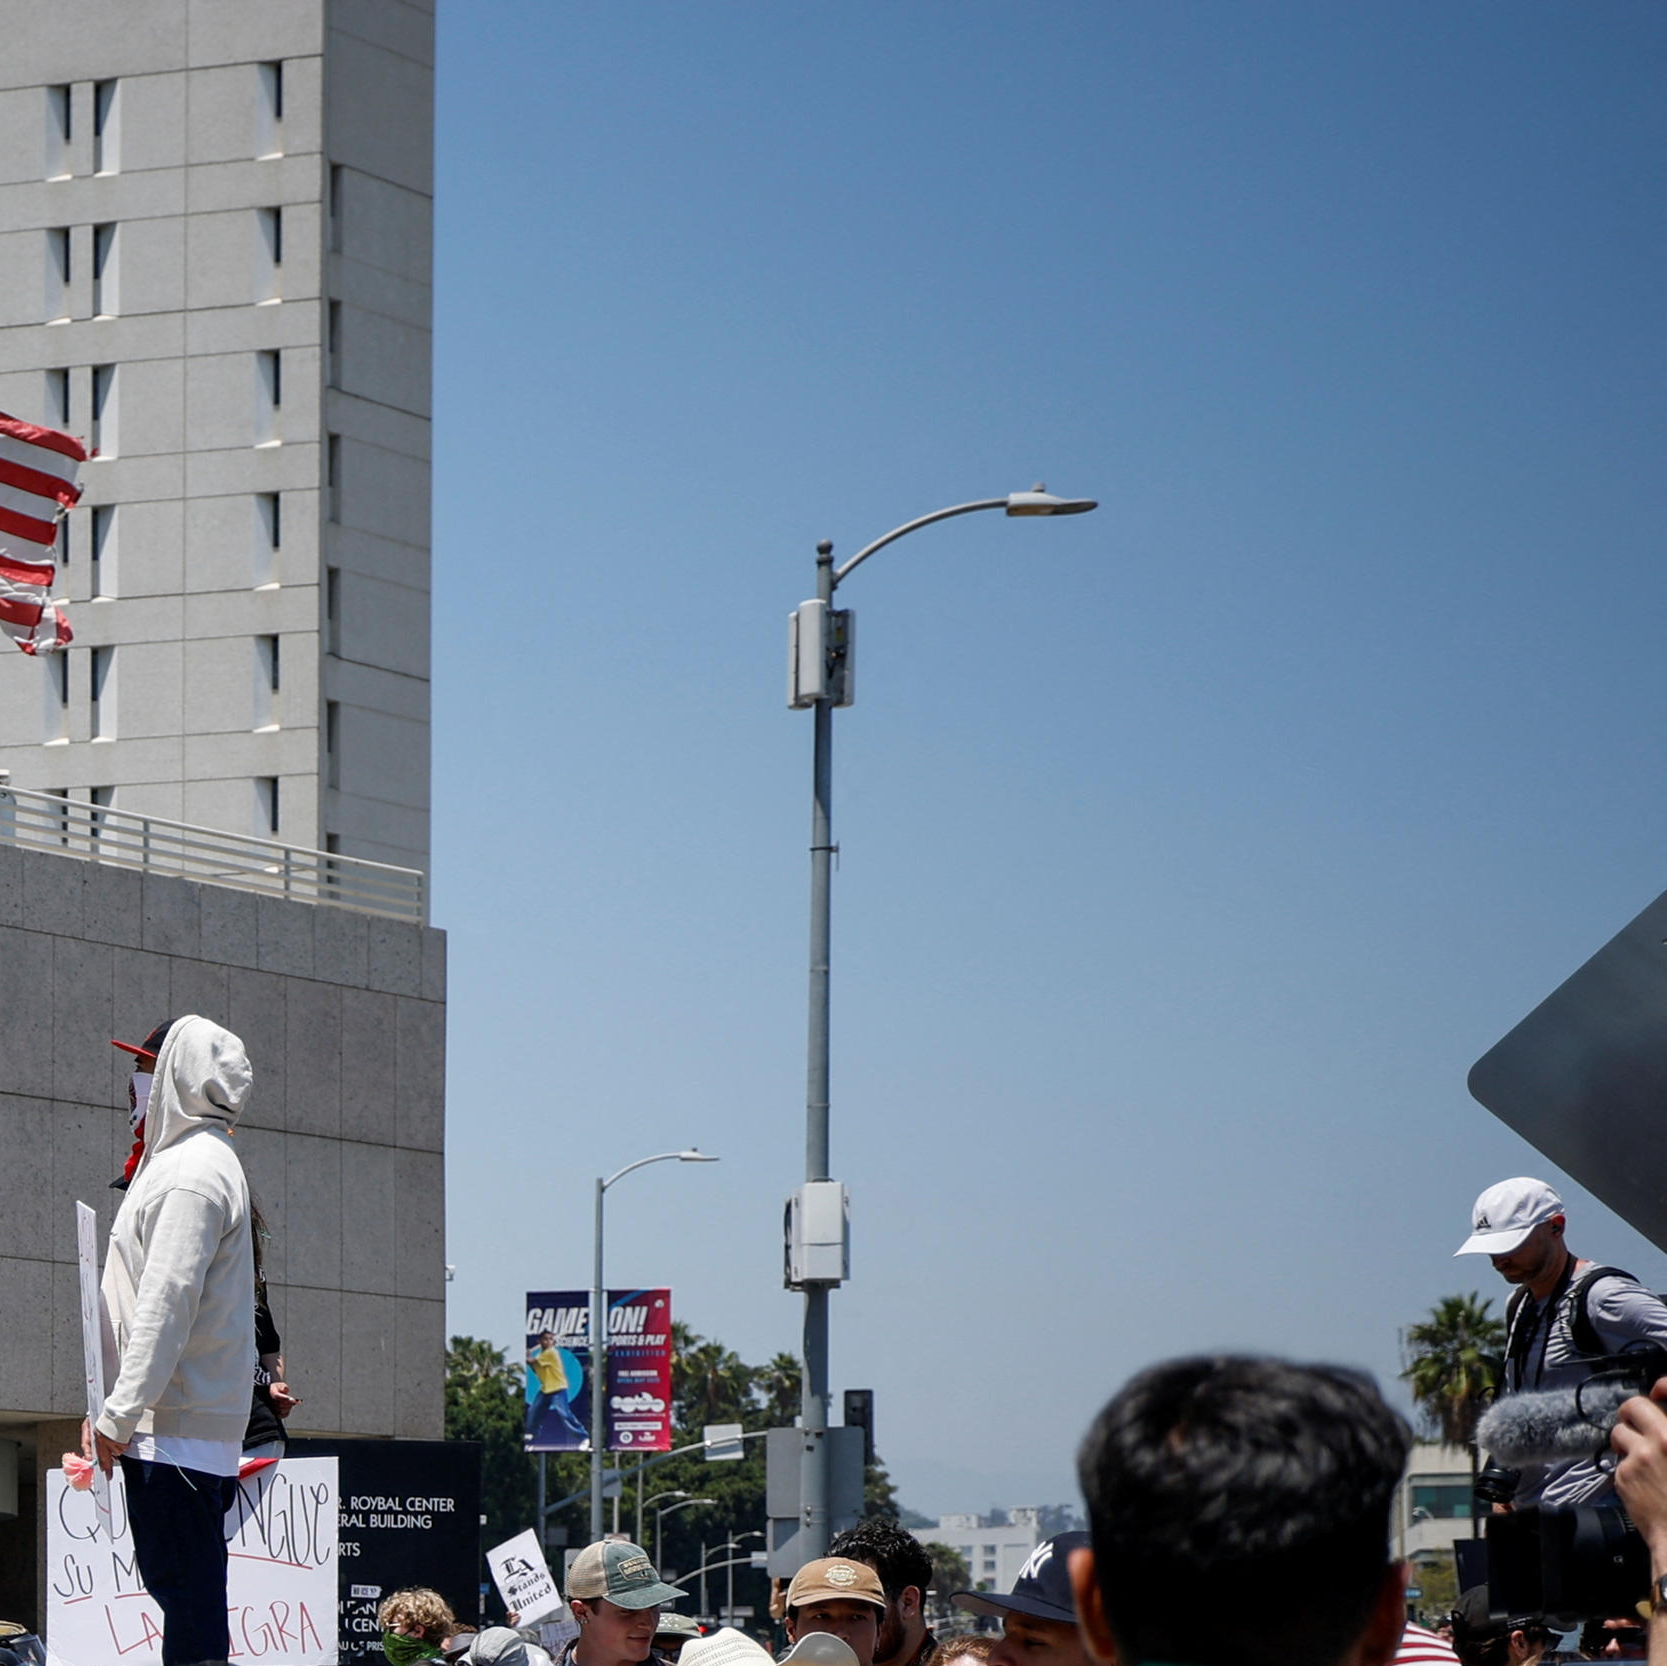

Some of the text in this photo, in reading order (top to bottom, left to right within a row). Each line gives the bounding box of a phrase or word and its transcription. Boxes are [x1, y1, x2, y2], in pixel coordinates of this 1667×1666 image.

[527, 1306, 648, 1335] GAME ON!
[645, 1334, 667, 1346] PLAY
[350, 1497, 403, 1512] ROYBAL
[406, 1497, 455, 1512] CENTER
[59, 1473, 331, 1566] QU NGUE
[370, 1514, 433, 1529] BUILDING
[500, 1556, 535, 1582] LA
[509, 1582, 553, 1612] United
[227, 1600, 323, 1658] IGRA
[367, 1641, 385, 1652] PRIS
